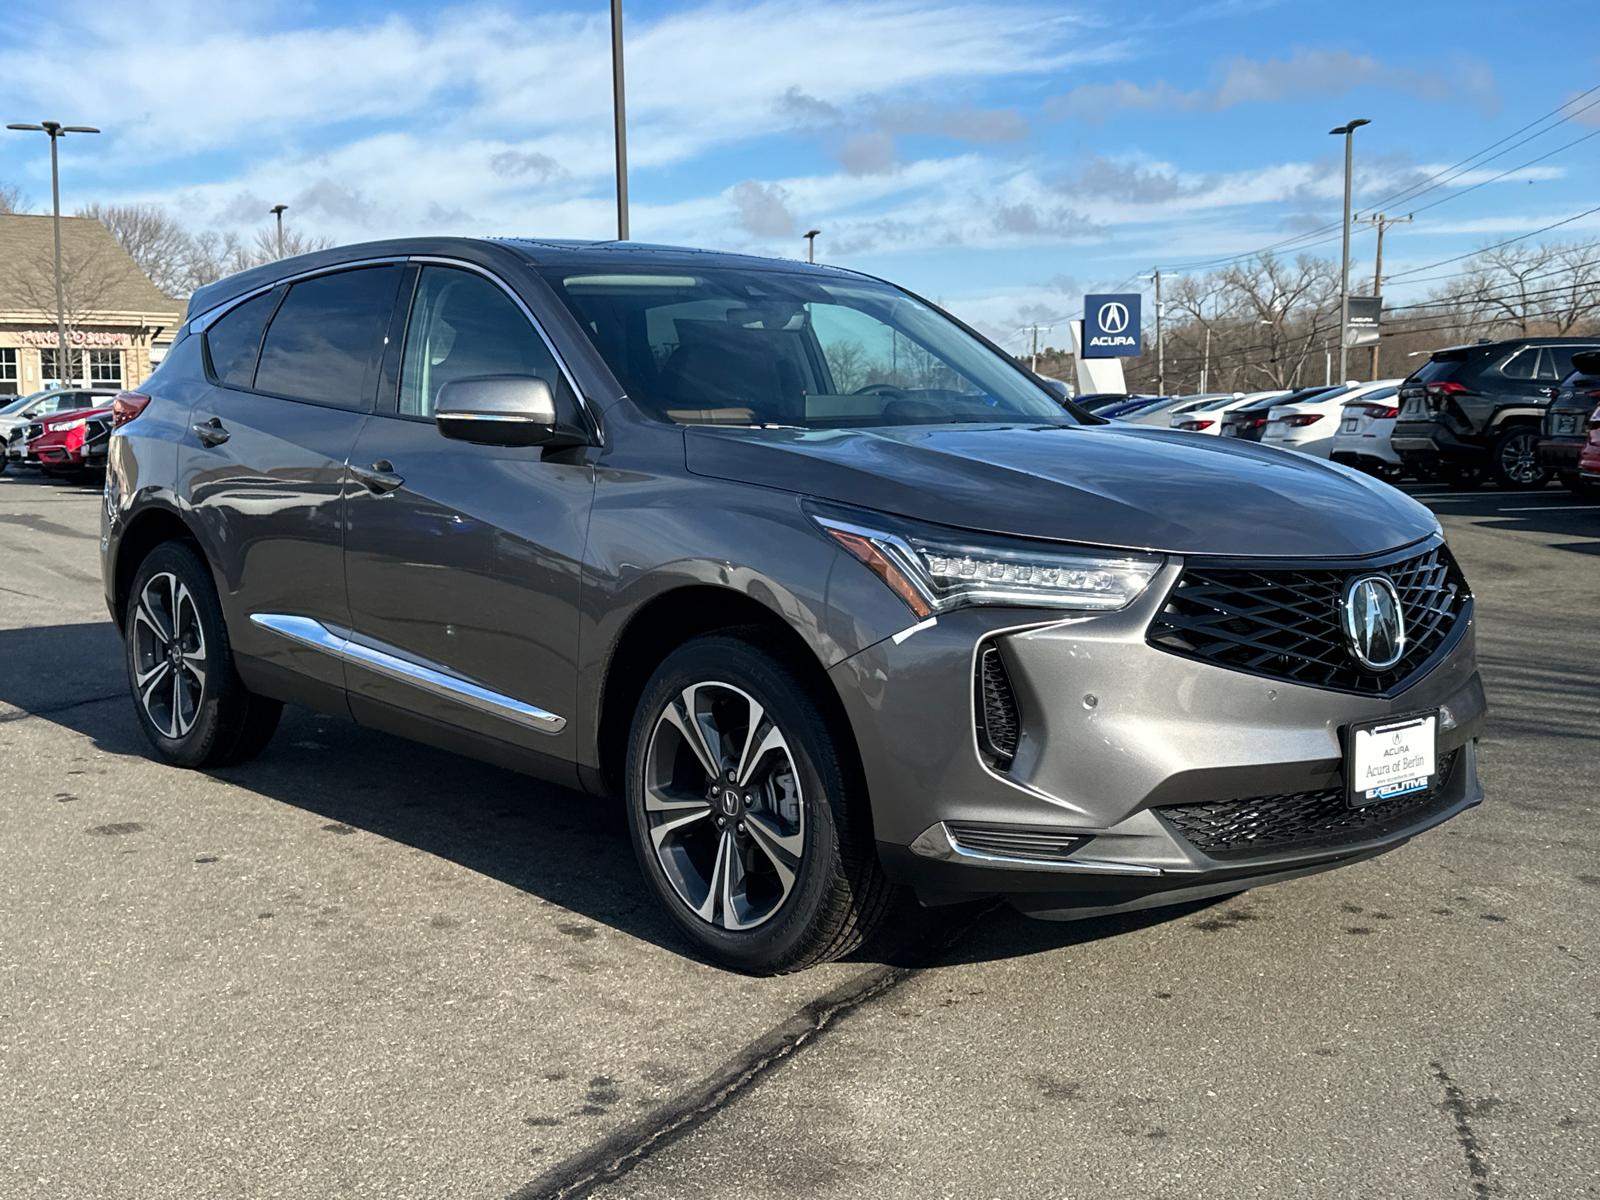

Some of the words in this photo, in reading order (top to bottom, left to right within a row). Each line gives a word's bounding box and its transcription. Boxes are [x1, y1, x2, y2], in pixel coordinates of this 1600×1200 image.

[1089, 336, 1136, 346] ACURA
[1383, 745, 1410, 757] ACURA
[1365, 764, 1390, 778] Acura
[1392, 760, 1401, 773] of
[1402, 754, 1425, 770] Berlin
[1365, 776, 1428, 799] EXECUTIVE
